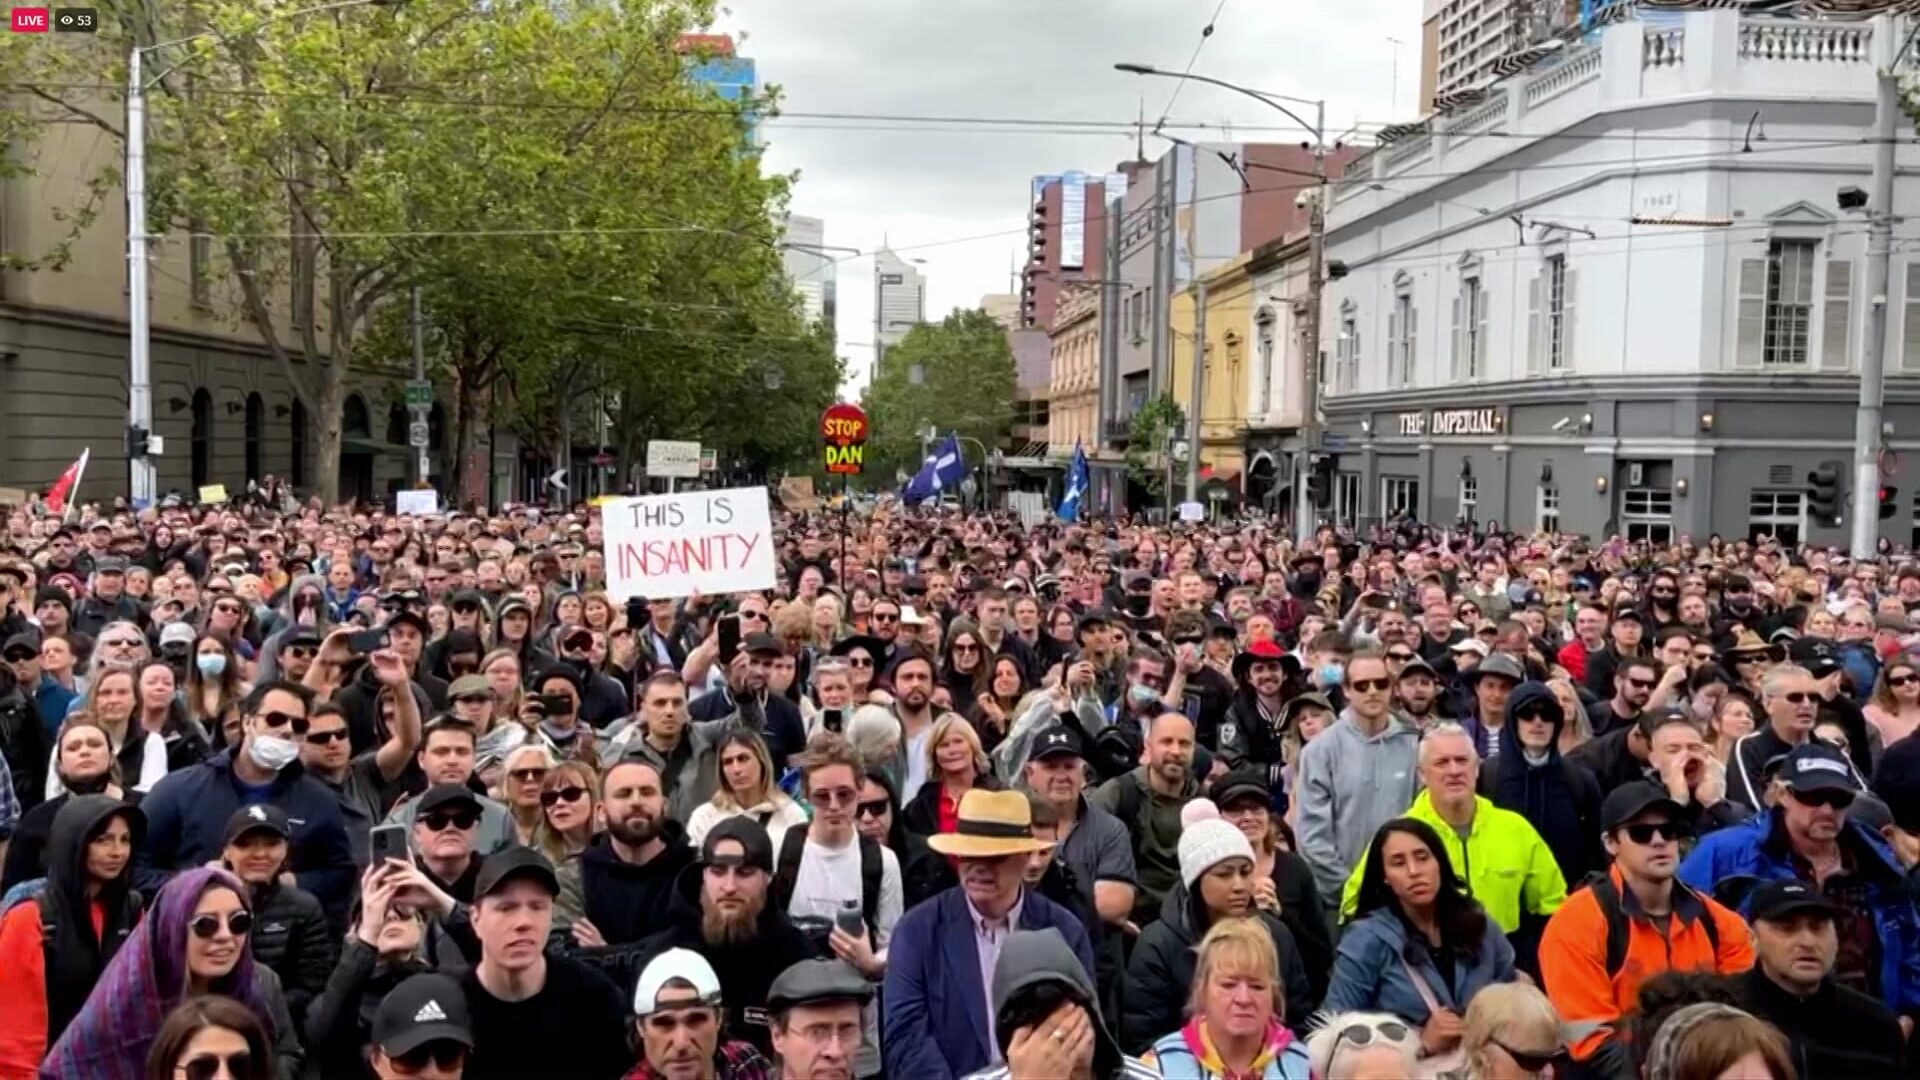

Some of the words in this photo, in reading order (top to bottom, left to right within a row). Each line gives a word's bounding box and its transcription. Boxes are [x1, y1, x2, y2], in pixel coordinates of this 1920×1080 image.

[824, 418, 862, 437] STOP
[1432, 408, 1496, 434] IMPERIAL
[826, 445, 863, 465] DAN
[628, 500, 685, 529] THIS
[706, 497, 734, 524] IS
[617, 531, 760, 580] INSANITY
